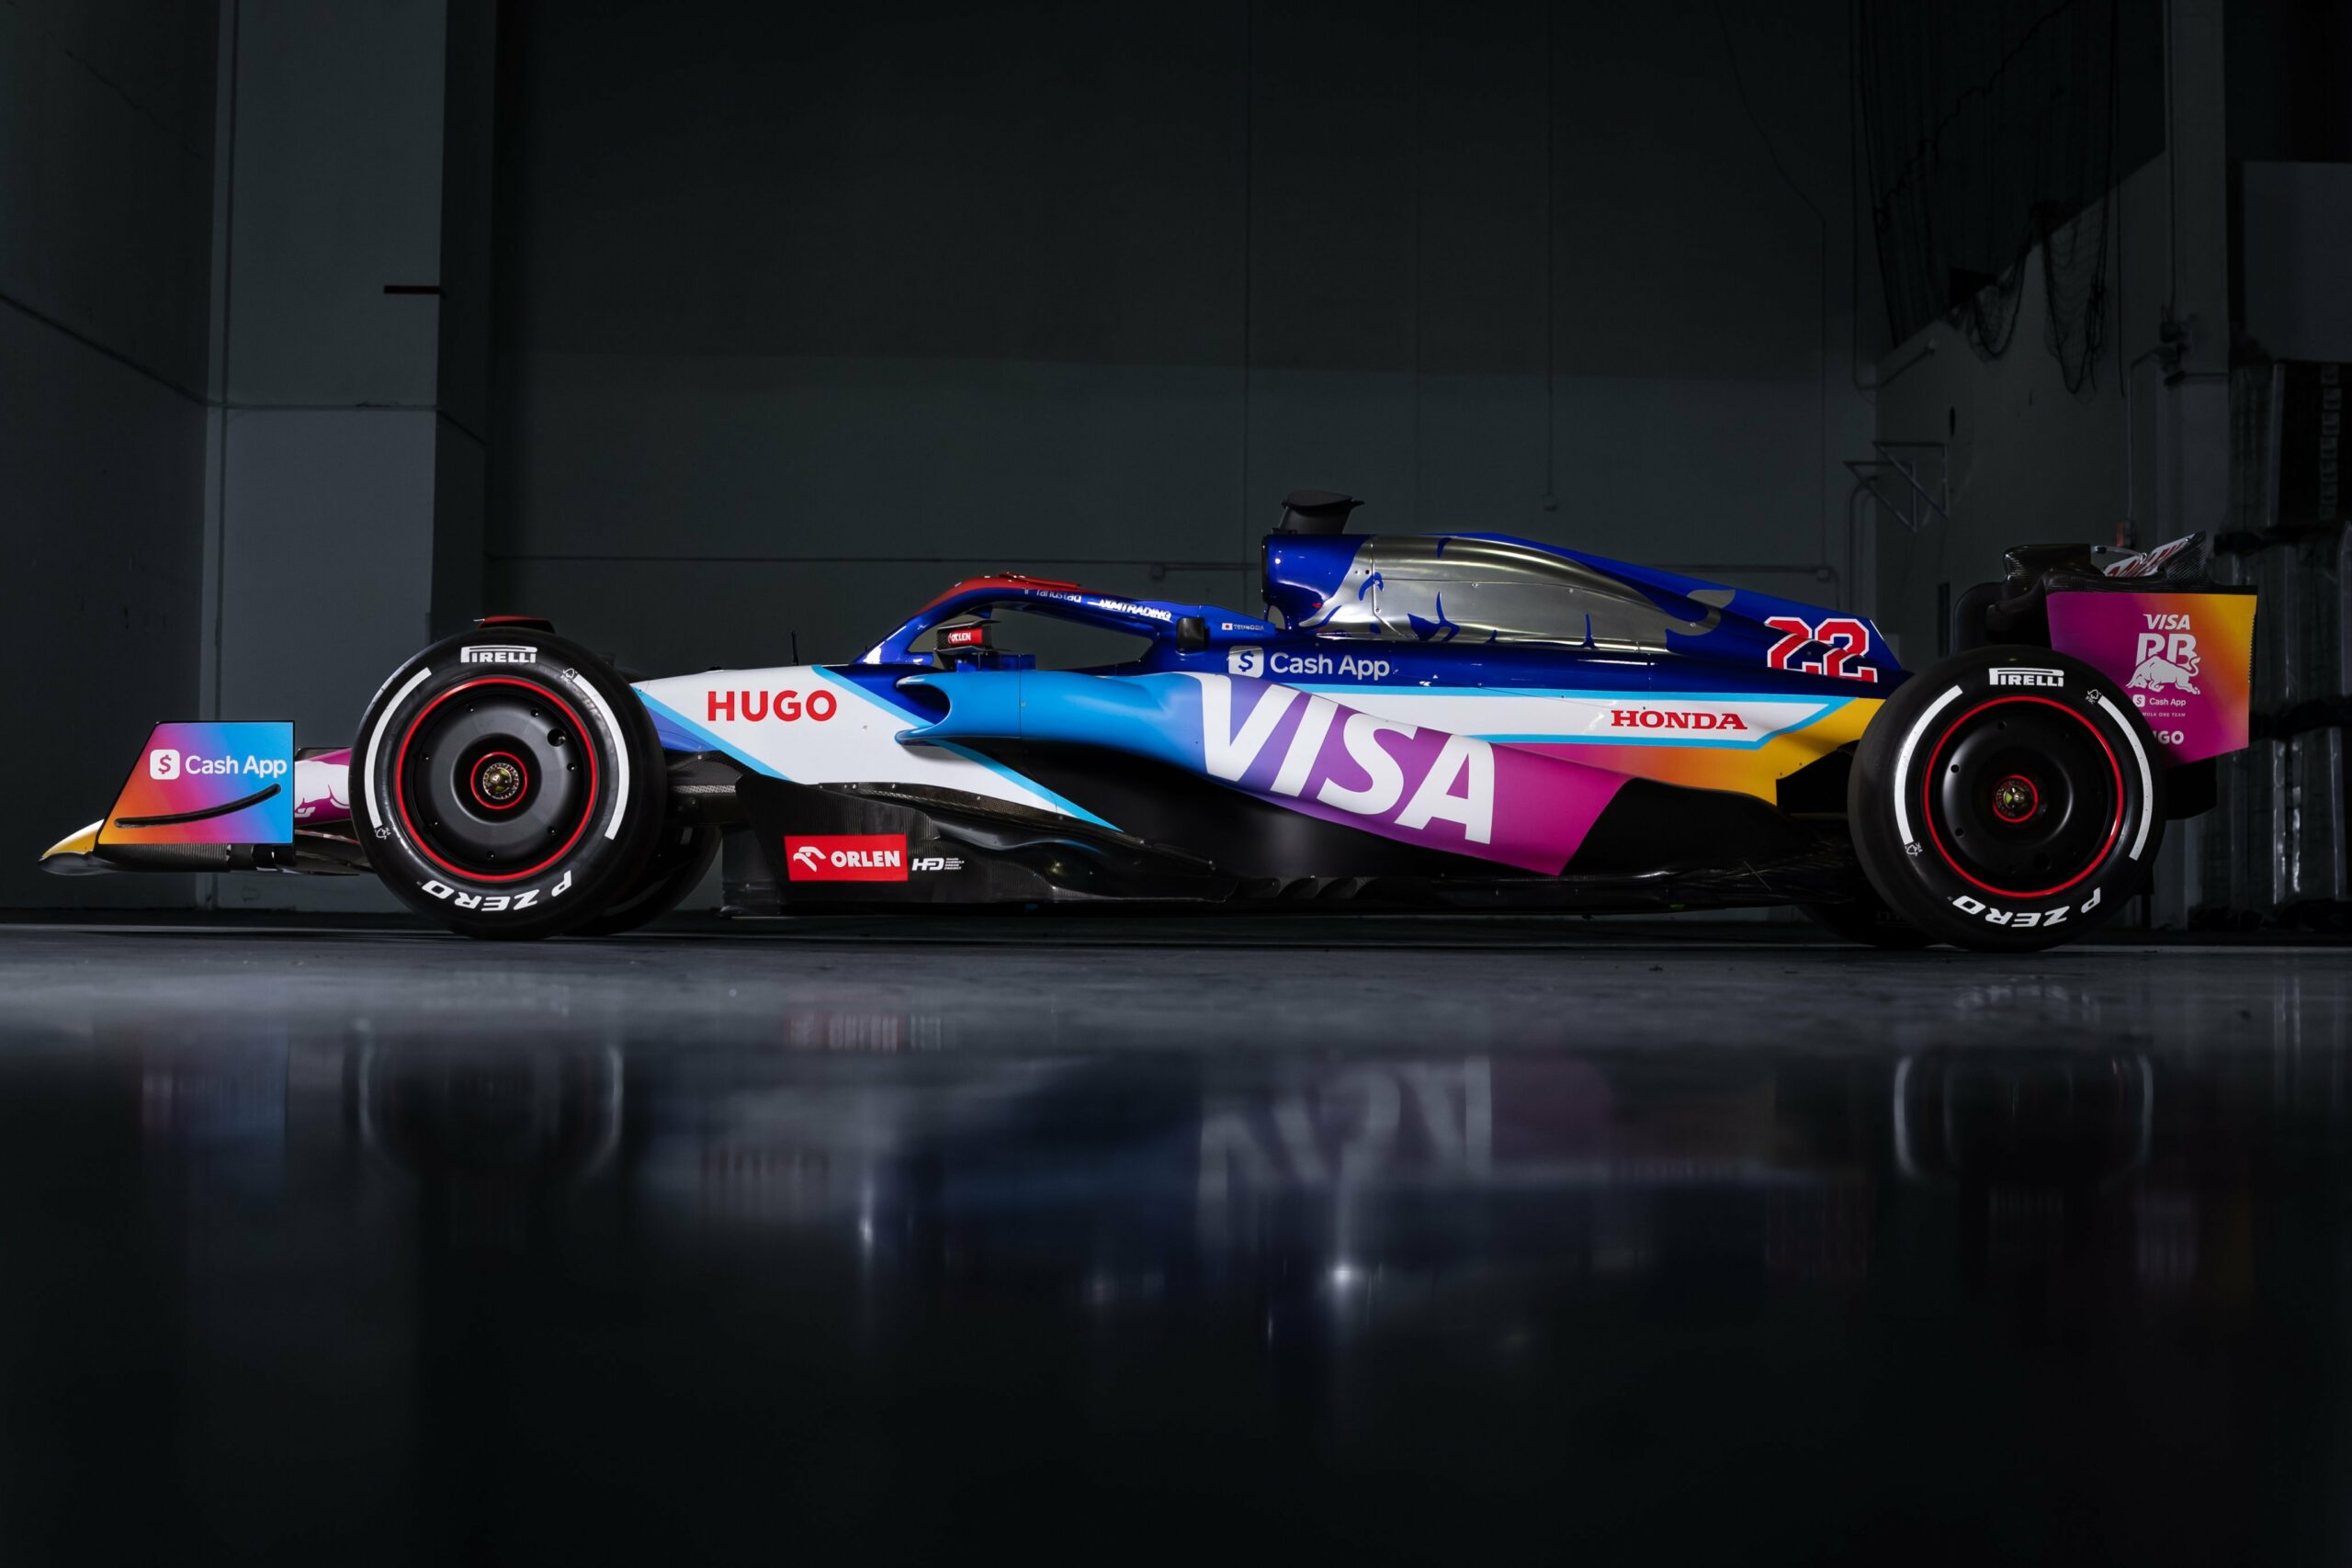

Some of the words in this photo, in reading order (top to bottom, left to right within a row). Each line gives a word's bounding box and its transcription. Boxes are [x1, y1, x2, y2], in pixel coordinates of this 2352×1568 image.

[2143, 615, 2191, 630] VISA
[460, 645, 537, 663] PIRELLI
[1764, 616, 1878, 682] 22
[1270, 652, 1332, 675] Cash
[1338, 654, 1390, 681] App
[1989, 668, 2064, 687] PIRELLI
[707, 690, 837, 722] HUGO
[2149, 697, 2169, 705] Cash
[2170, 698, 2187, 707] App
[1611, 710, 1747, 730] HONDA
[2153, 730, 2185, 745] GO
[186, 755, 239, 775] Cash
[243, 755, 288, 778] App
[1181, 671, 1495, 844] VISA
[831, 851, 900, 868] ORLEN
[422, 880, 540, 912] ZERO
[552, 870, 571, 897] P
[1952, 896, 2070, 928] ZERO
[2081, 887, 2101, 914] P
